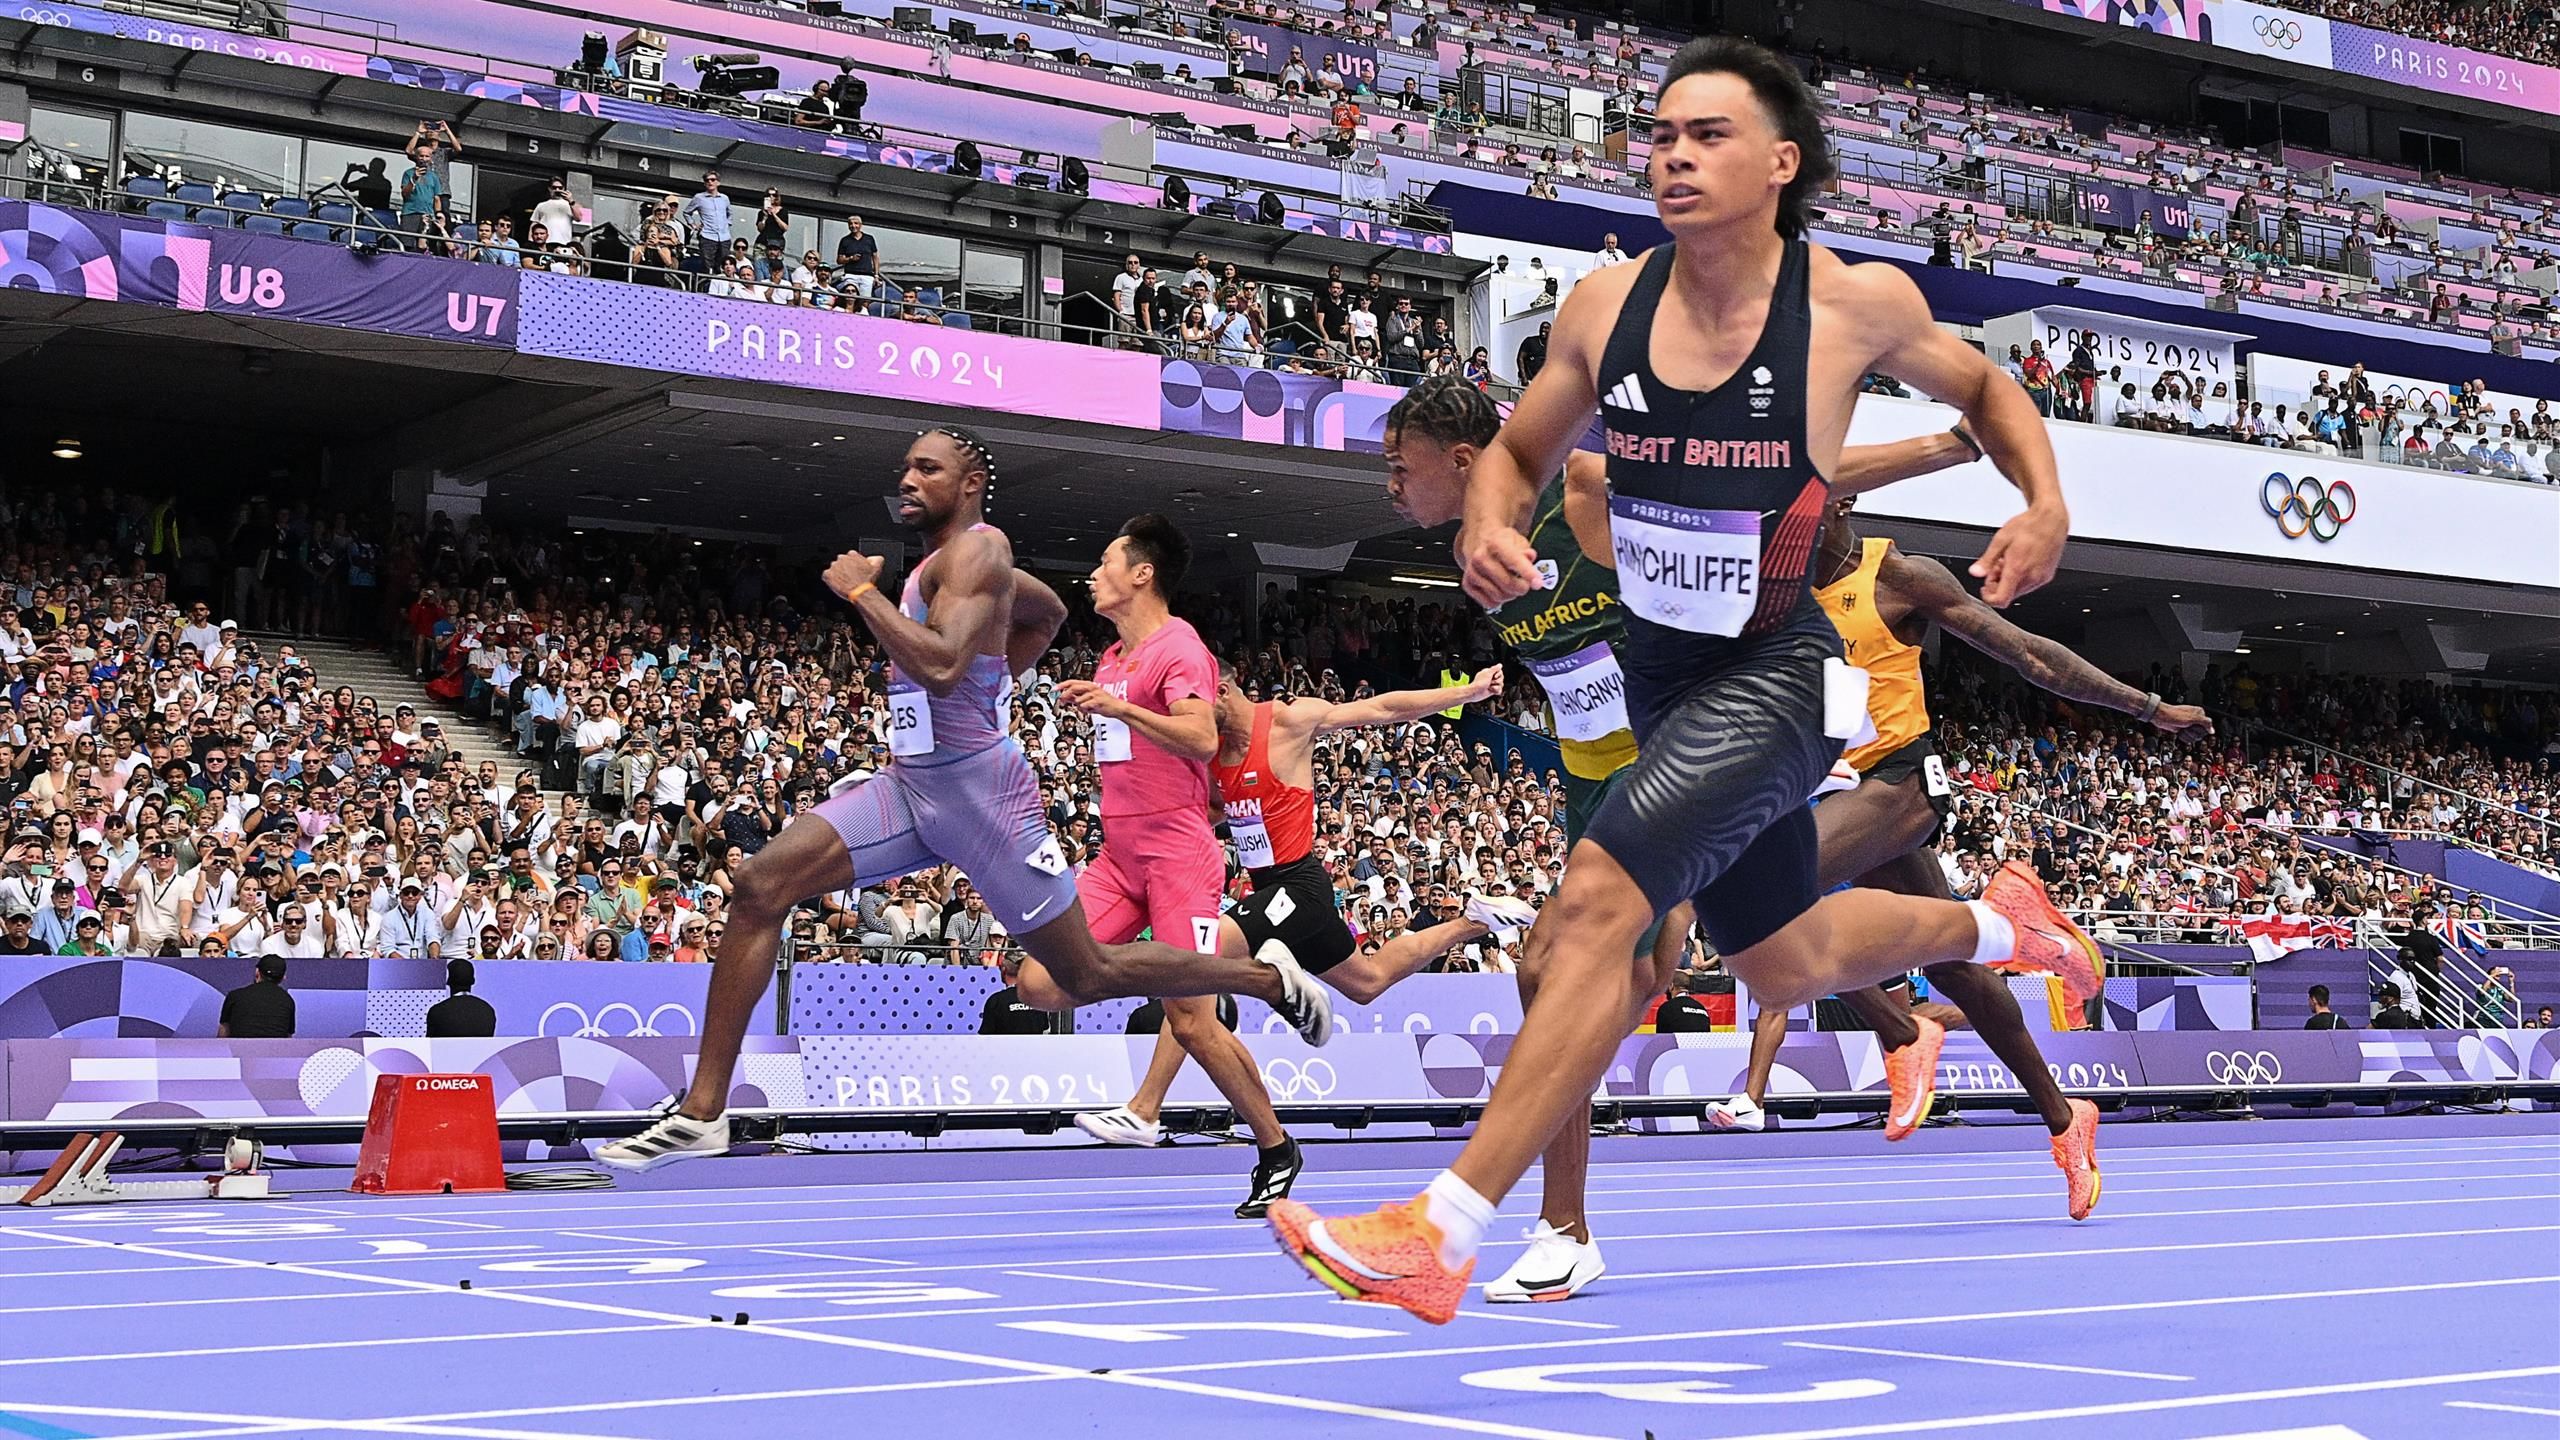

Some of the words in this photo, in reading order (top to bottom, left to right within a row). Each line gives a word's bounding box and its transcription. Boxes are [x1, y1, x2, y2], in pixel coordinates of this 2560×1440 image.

[81, 67, 95, 83] 6
[2458, 62, 2524, 94] 2024
[528, 139, 540, 154] 5
[638, 157, 650, 171] 4
[1008, 213, 1019, 229] 3
[2163, 206, 2188, 229] U11
[1103, 230, 1113, 245] 2
[218, 262, 285, 308] U8
[1421, 280, 1427, 292] 1
[447, 290, 507, 336] U7
[878, 341, 1003, 388] 2024
[2145, 340, 2219, 374] 2024
[1684, 438, 1791, 468] BRITAIN
[1672, 511, 1711, 526] 2024
[1534, 591, 1615, 636] AFRICA
[1200, 925, 1209, 946] 7
[430, 1078, 480, 1091] OMEGA
[990, 1074, 1108, 1104] 2024
